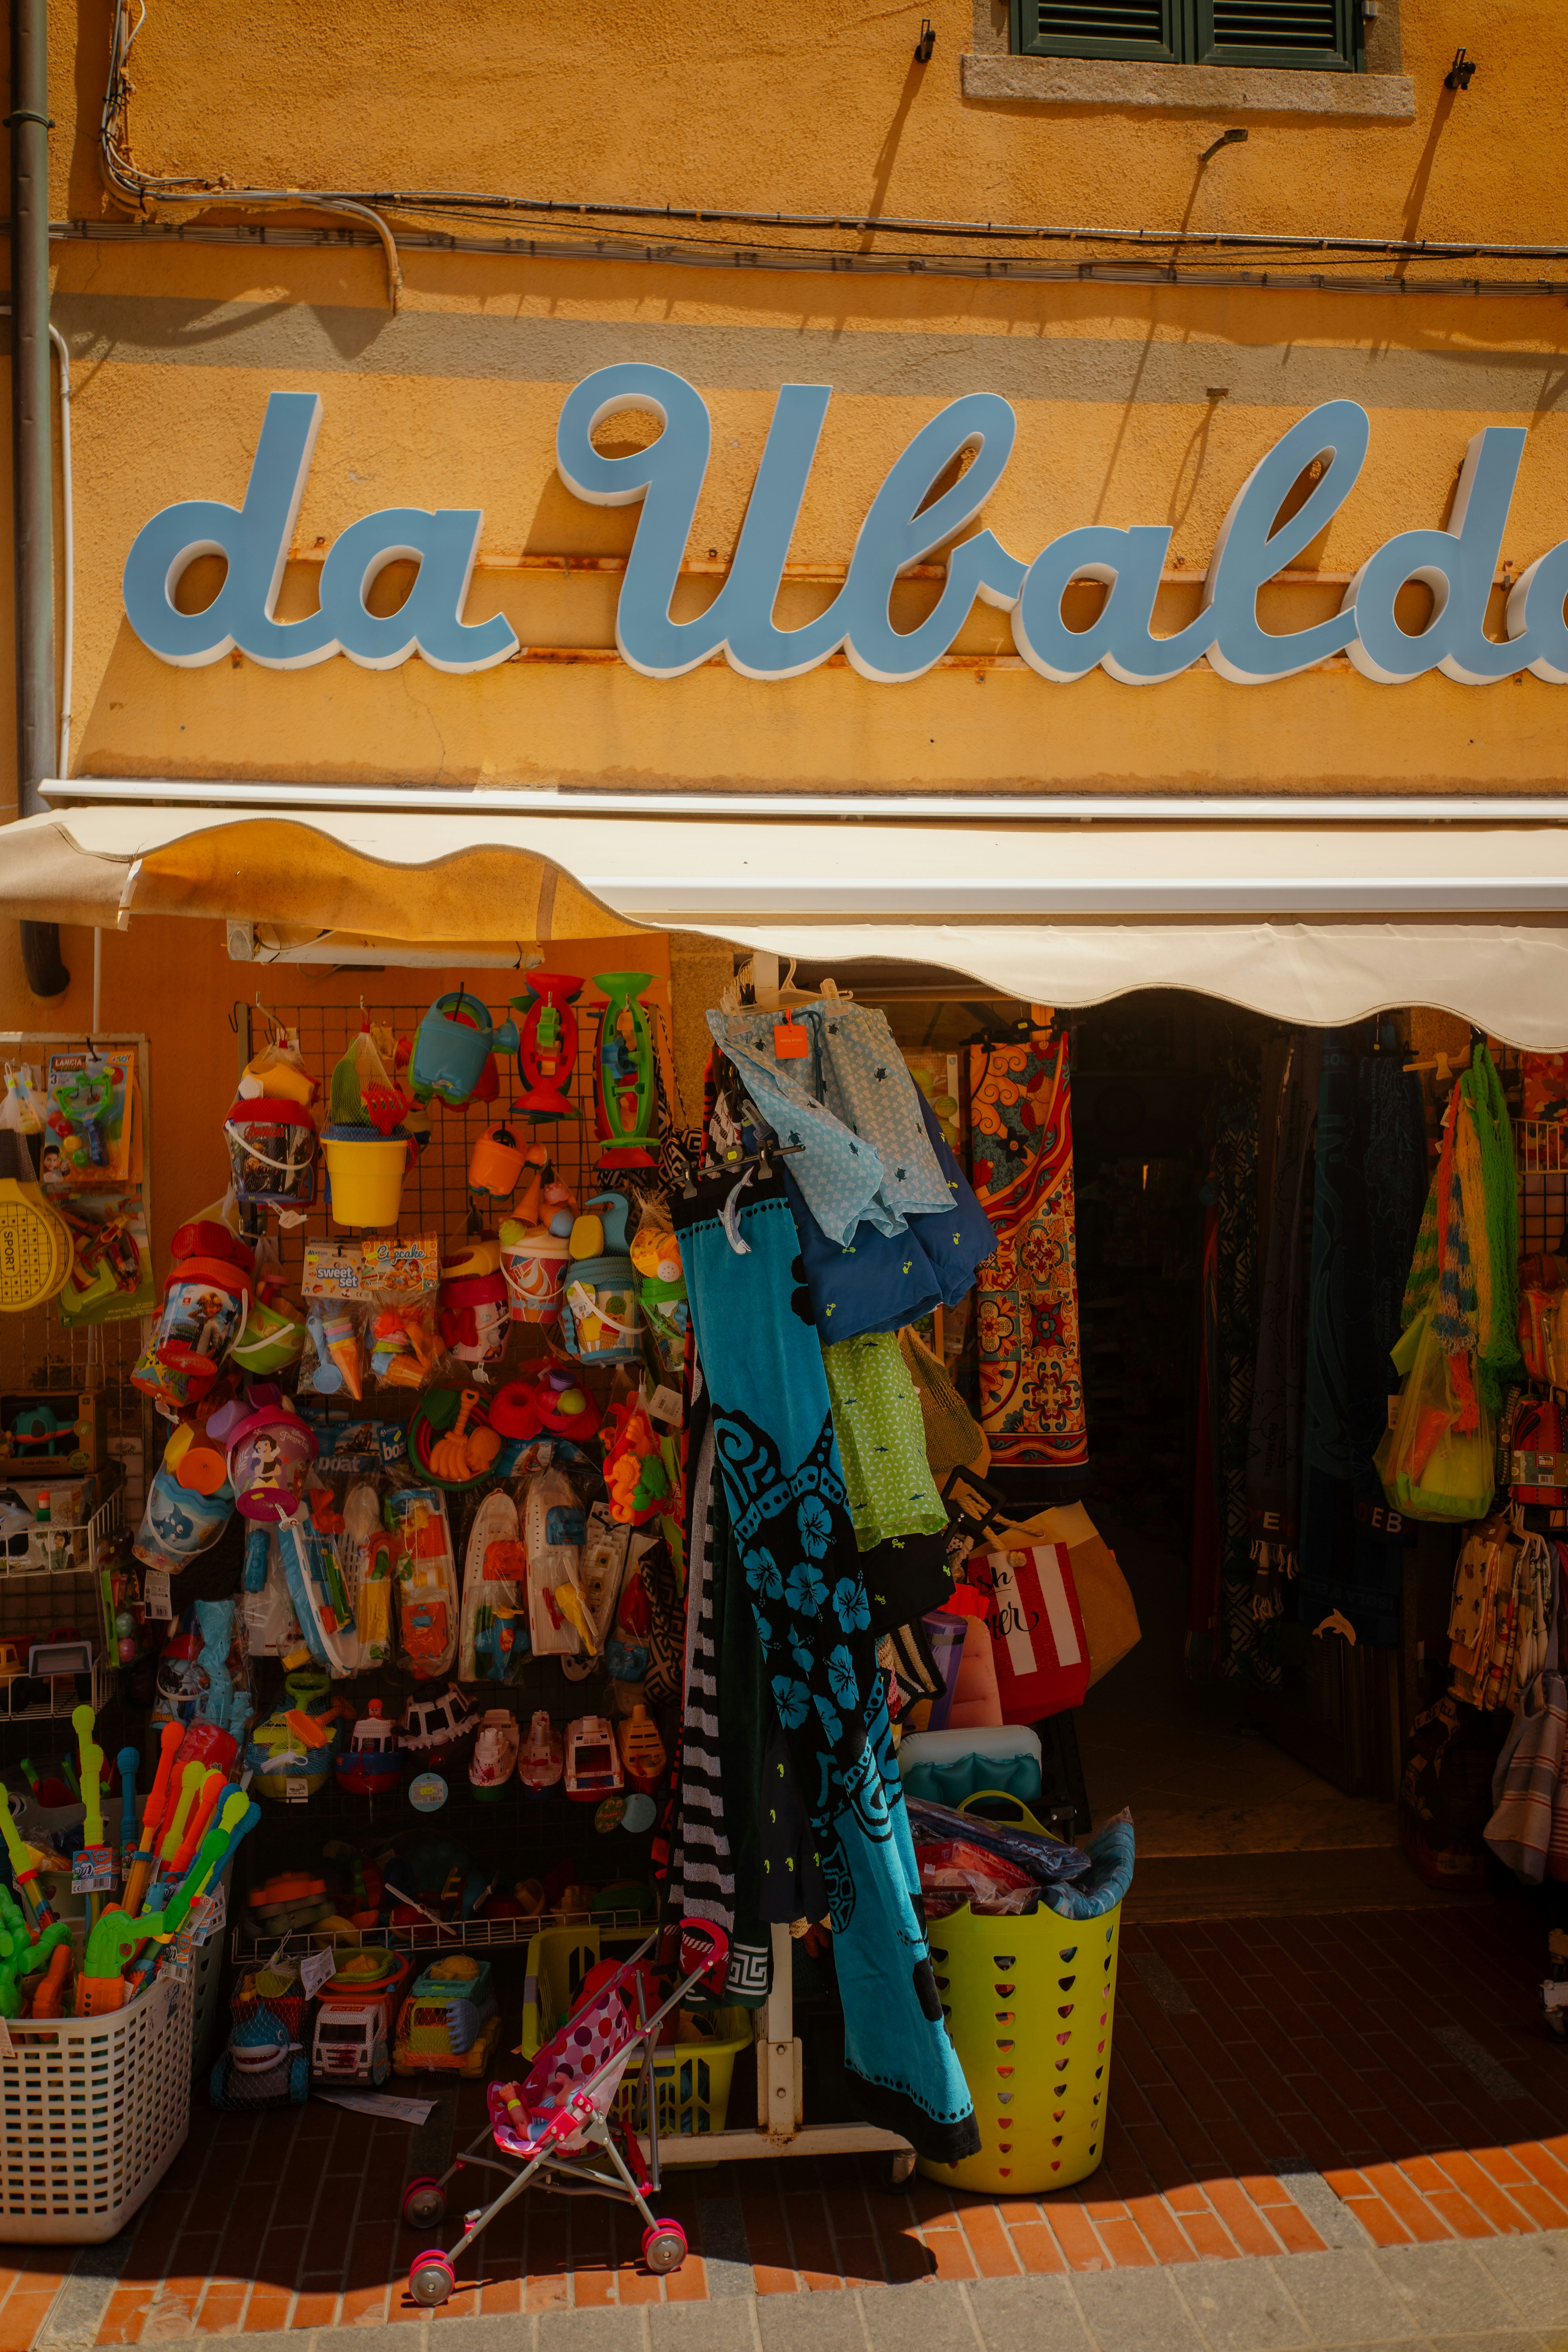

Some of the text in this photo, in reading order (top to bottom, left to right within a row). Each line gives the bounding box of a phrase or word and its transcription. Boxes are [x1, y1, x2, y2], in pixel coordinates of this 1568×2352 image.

[123, 391, 520, 673] da
[55, 1058, 82, 1067] LANCIA
[51, 1074, 57, 1084] 3
[4, 1231, 15, 1272] SPORT
[317, 1267, 352, 1278] sweet
[339, 1275, 358, 1287] set
[512, 1296, 526, 1308] Ice
[280, 1431, 309, 1454] PRINCESS
[603, 1811, 619, 1820] POLESIE
